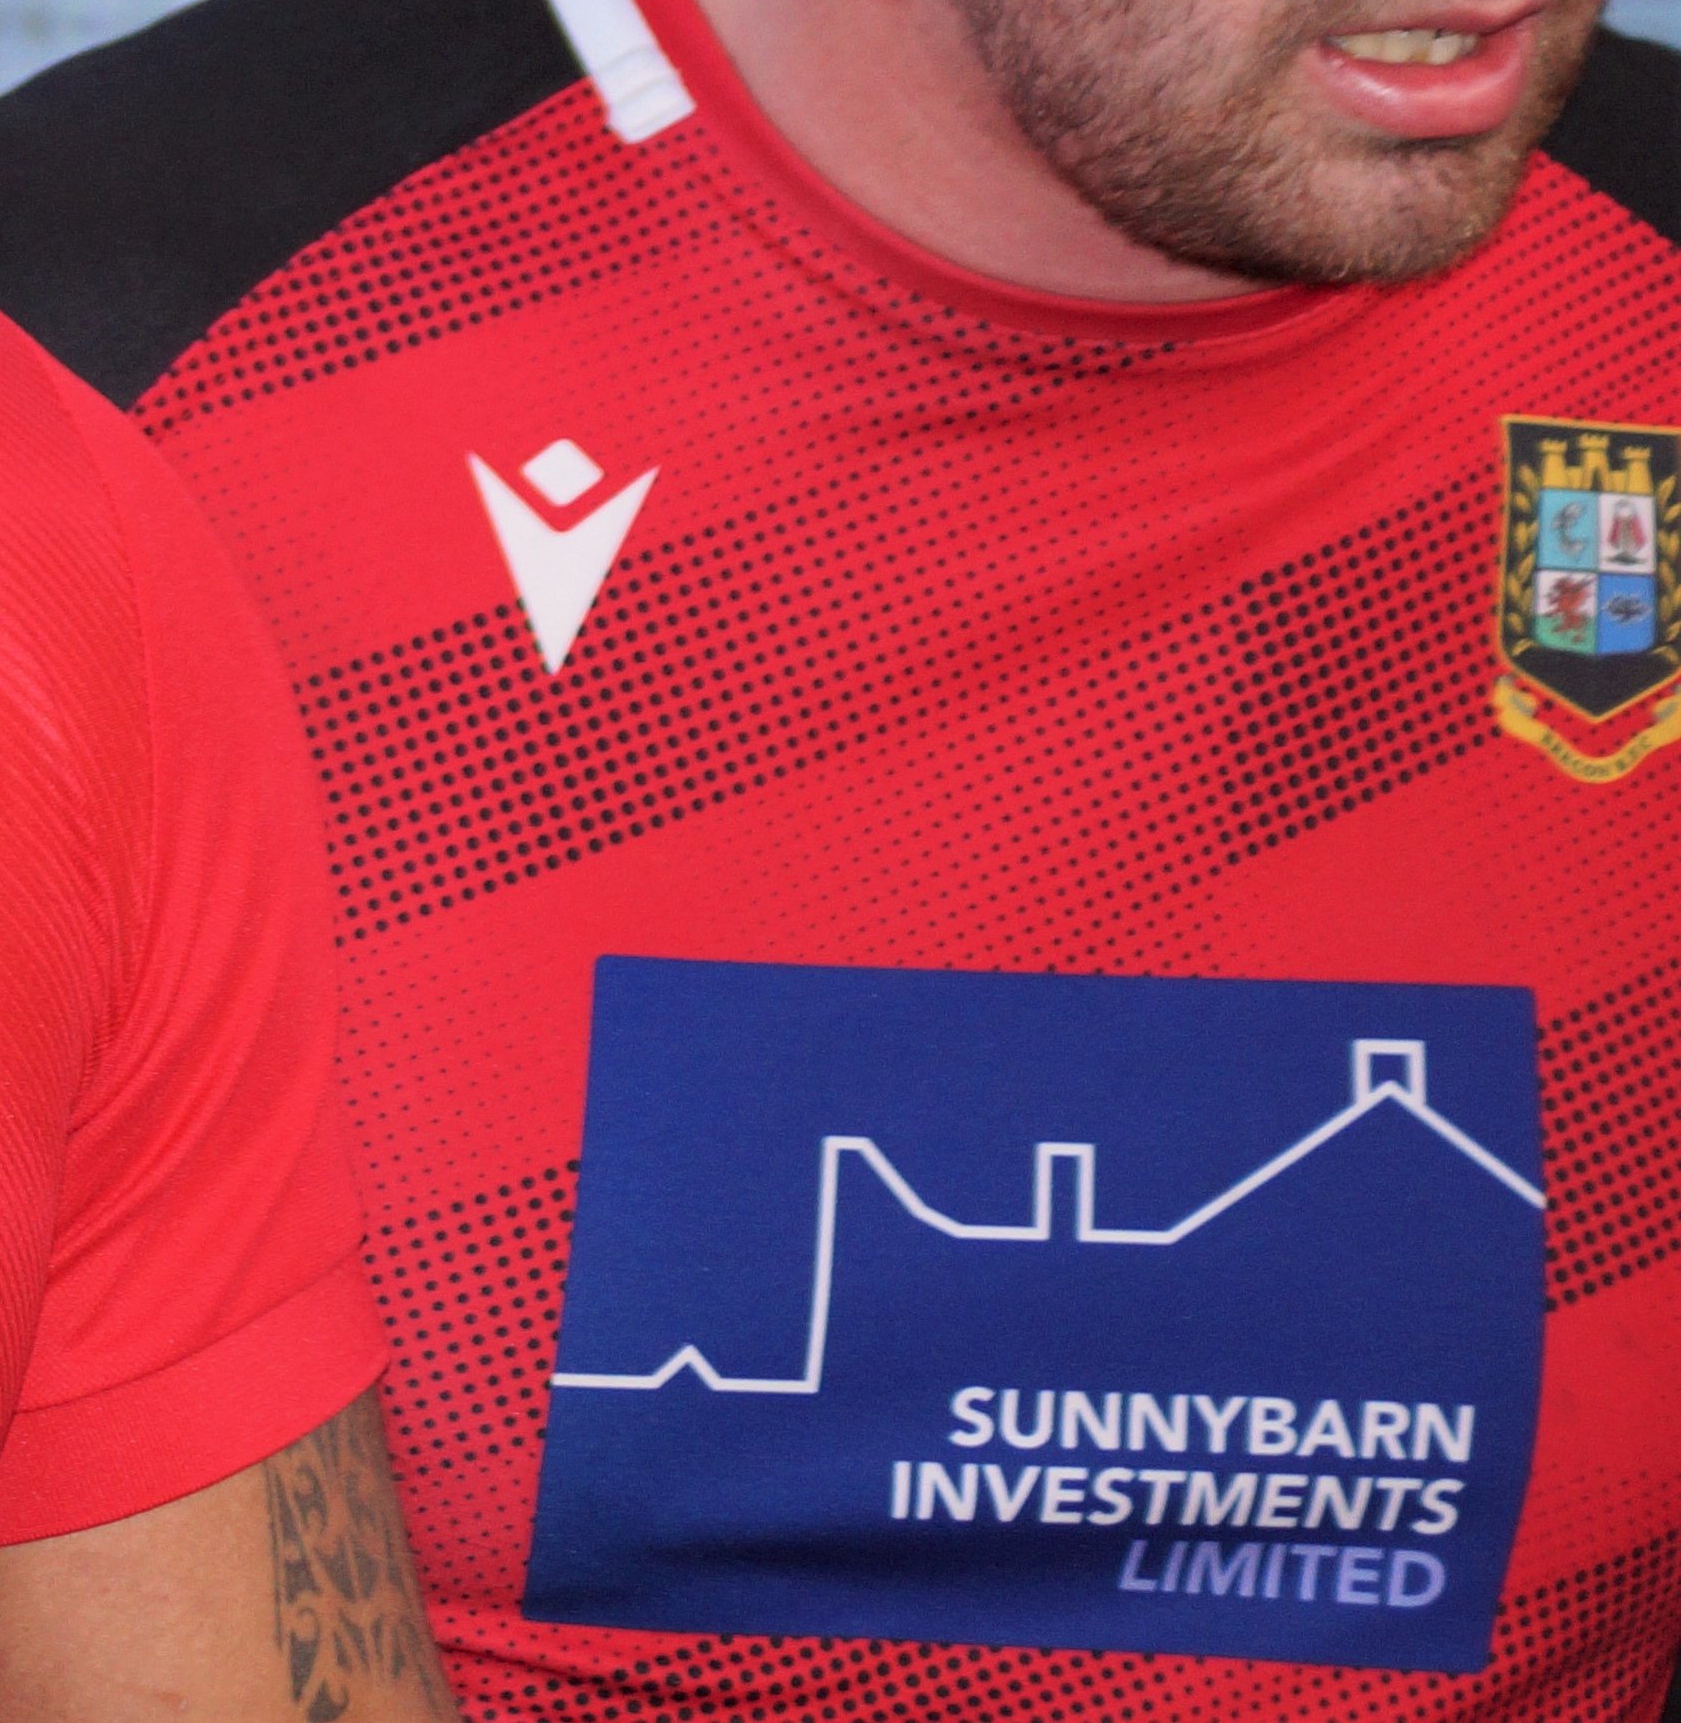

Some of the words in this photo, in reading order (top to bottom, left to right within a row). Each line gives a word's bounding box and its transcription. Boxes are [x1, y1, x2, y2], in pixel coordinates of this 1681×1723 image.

[948, 1385, 1475, 1463] SUNNYBARN
[890, 1460, 1463, 1535] INVESTMENTS
[1117, 1540, 1446, 1609] LIMITED
